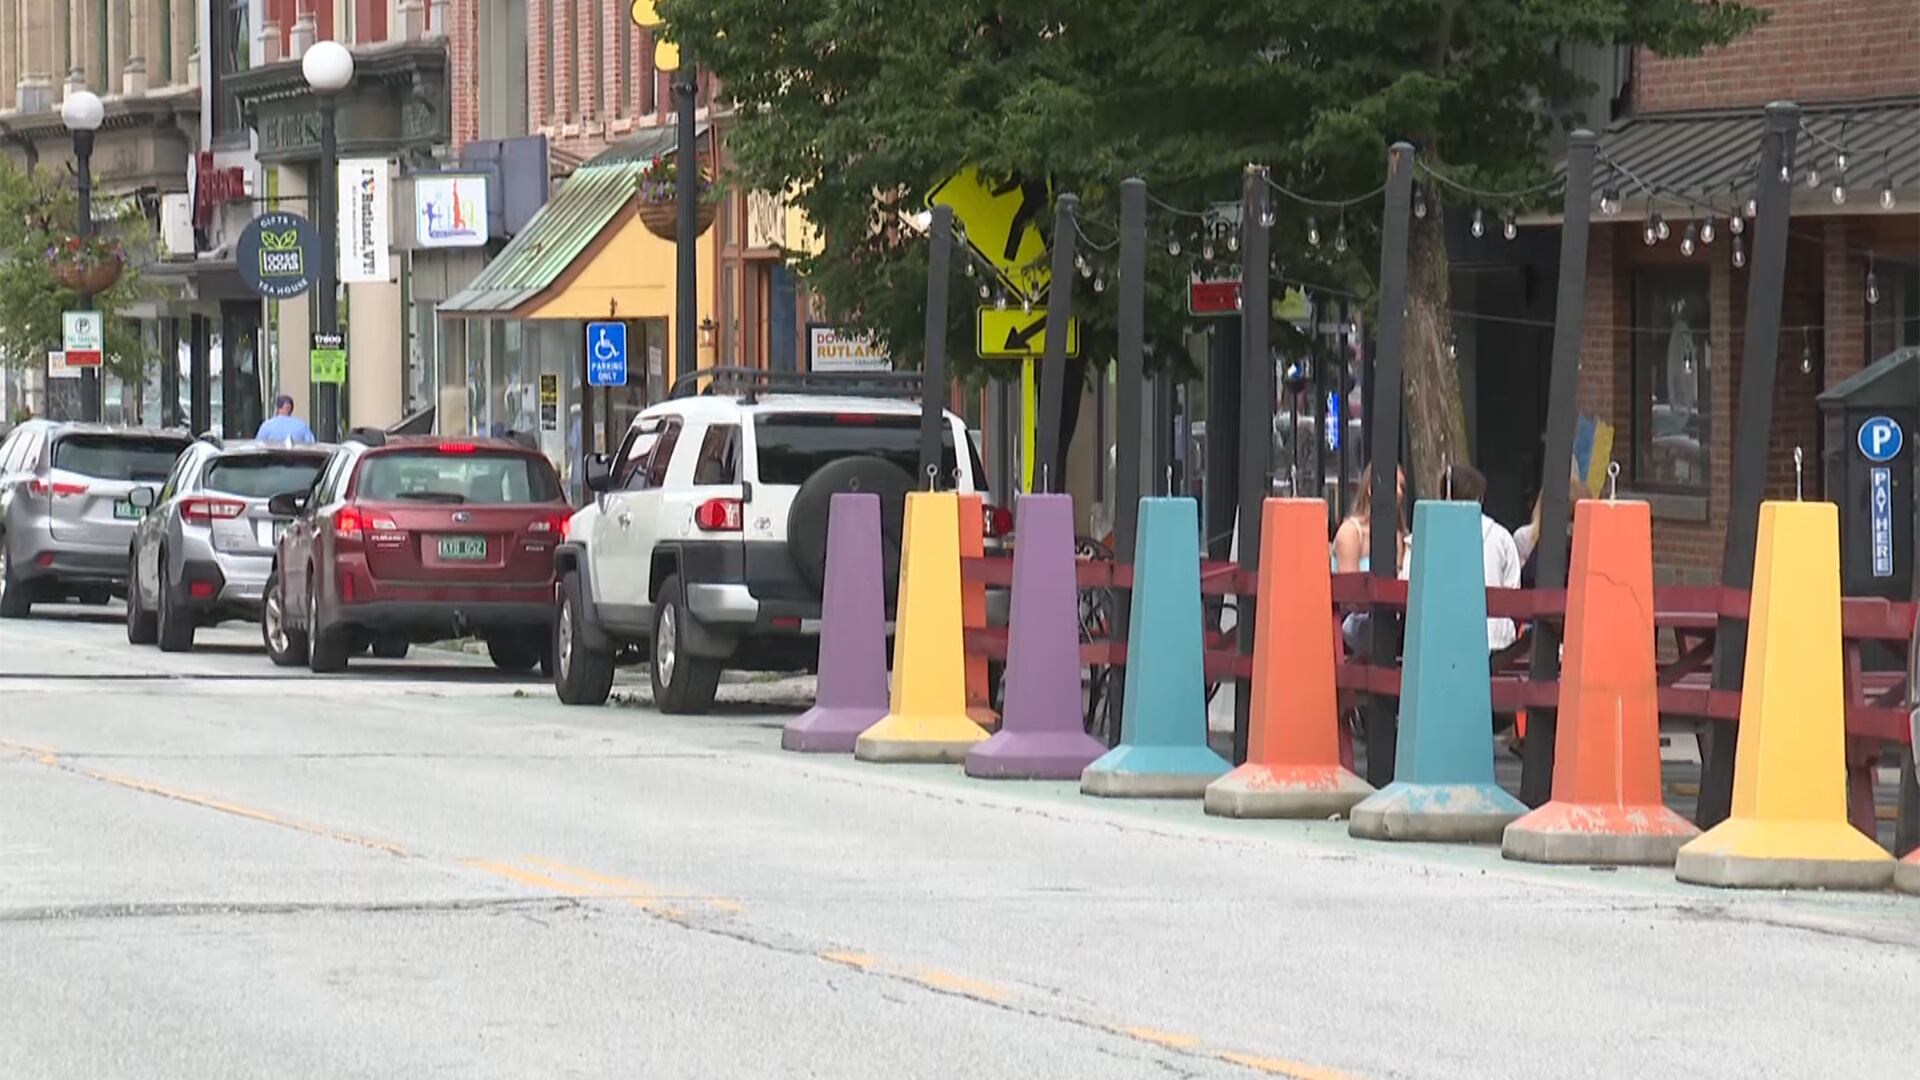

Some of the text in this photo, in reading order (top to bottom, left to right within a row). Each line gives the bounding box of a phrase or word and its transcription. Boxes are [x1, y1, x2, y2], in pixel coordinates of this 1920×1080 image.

[259, 278, 309, 295] TEA HOUSE
[591, 362, 624, 371] PARKING
[598, 372, 618, 381] ONLY
[1872, 425, 1893, 455] P
[1874, 472, 1889, 571] PAY HERE
